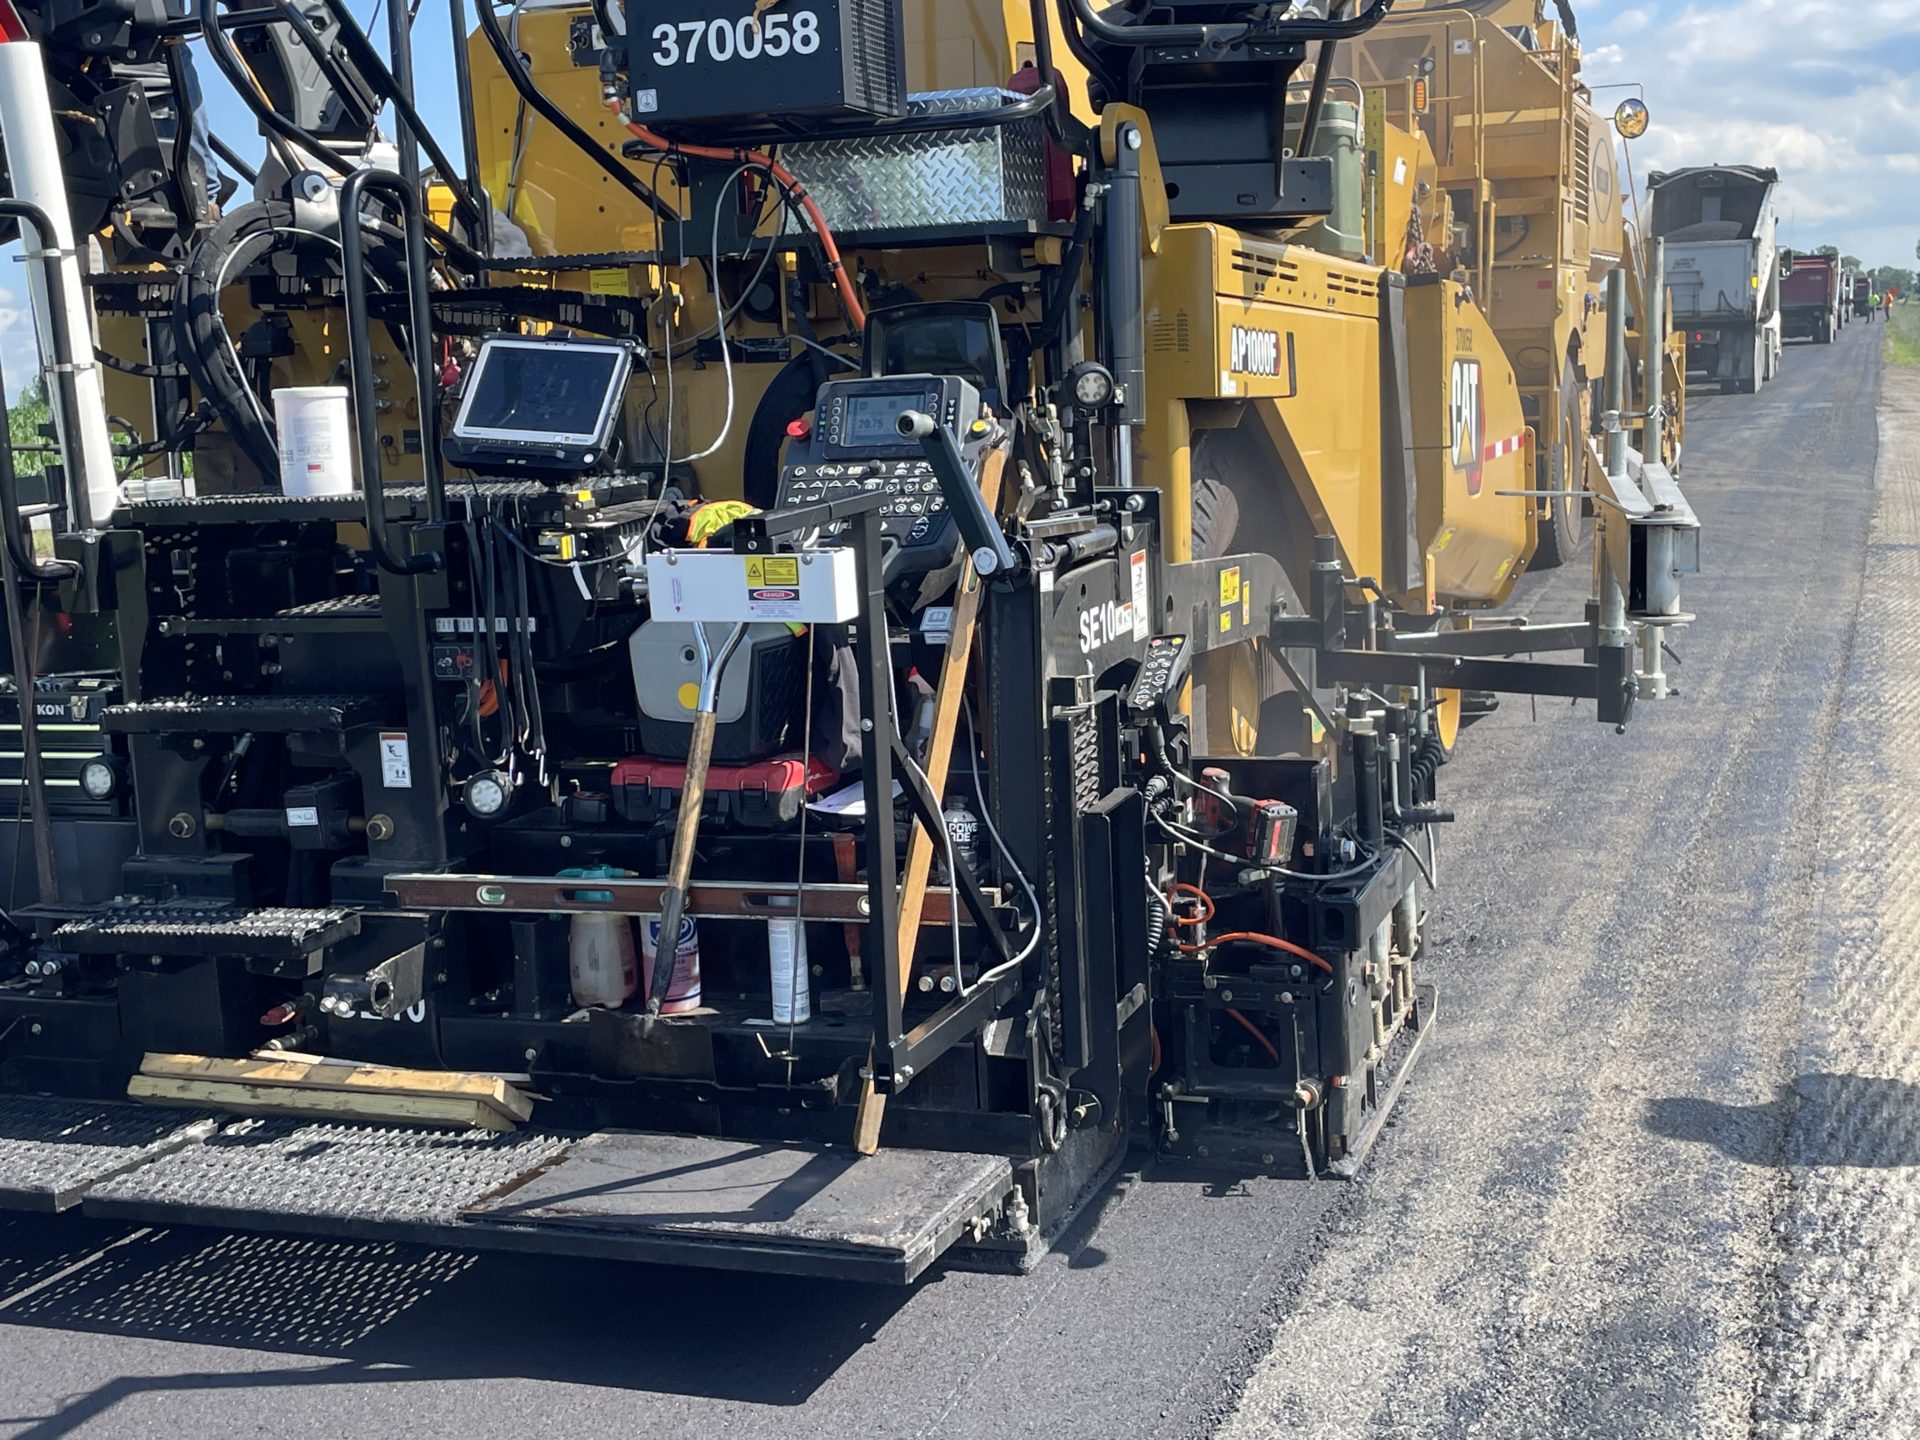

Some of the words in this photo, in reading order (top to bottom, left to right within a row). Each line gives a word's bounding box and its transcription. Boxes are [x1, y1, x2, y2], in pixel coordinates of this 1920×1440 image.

[652, 10, 821, 67] 370058
[1230, 325, 1278, 375] AP1000F
[1451, 360, 1479, 466] CAT
[1080, 600, 1116, 654] SE10
